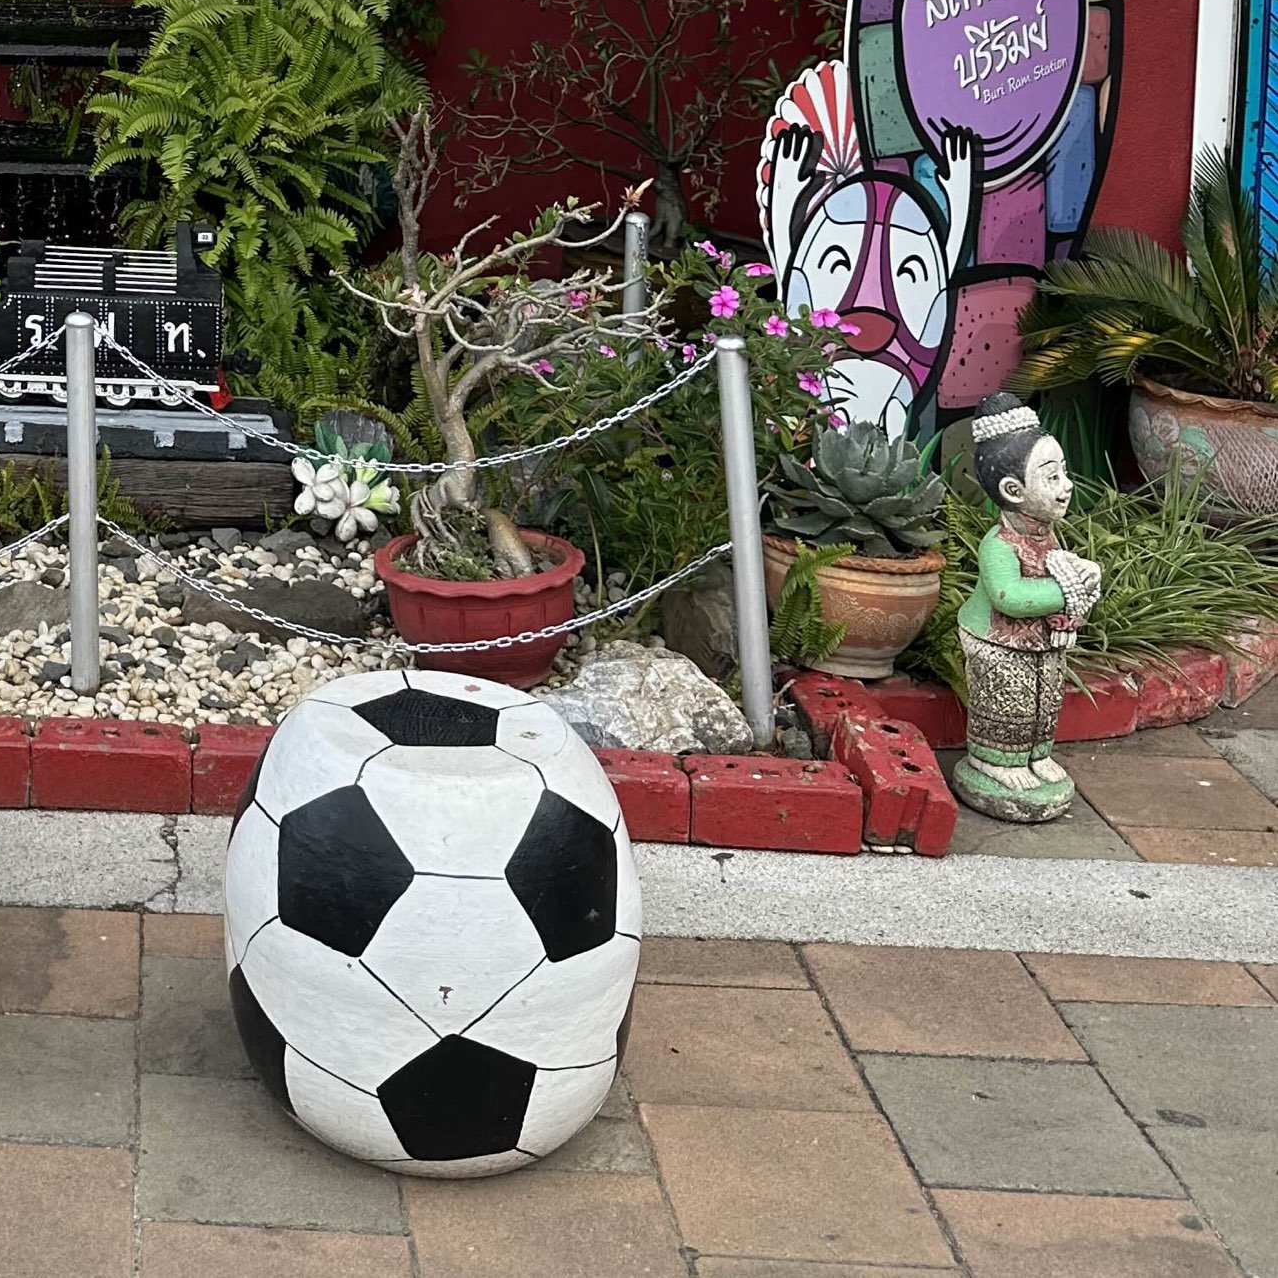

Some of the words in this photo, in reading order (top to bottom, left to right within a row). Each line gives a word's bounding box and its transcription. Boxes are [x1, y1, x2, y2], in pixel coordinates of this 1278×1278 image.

[982, 83, 1007, 105] Buri
[1007, 73, 1032, 94] Ram
[1032, 55, 1069, 81] Station
